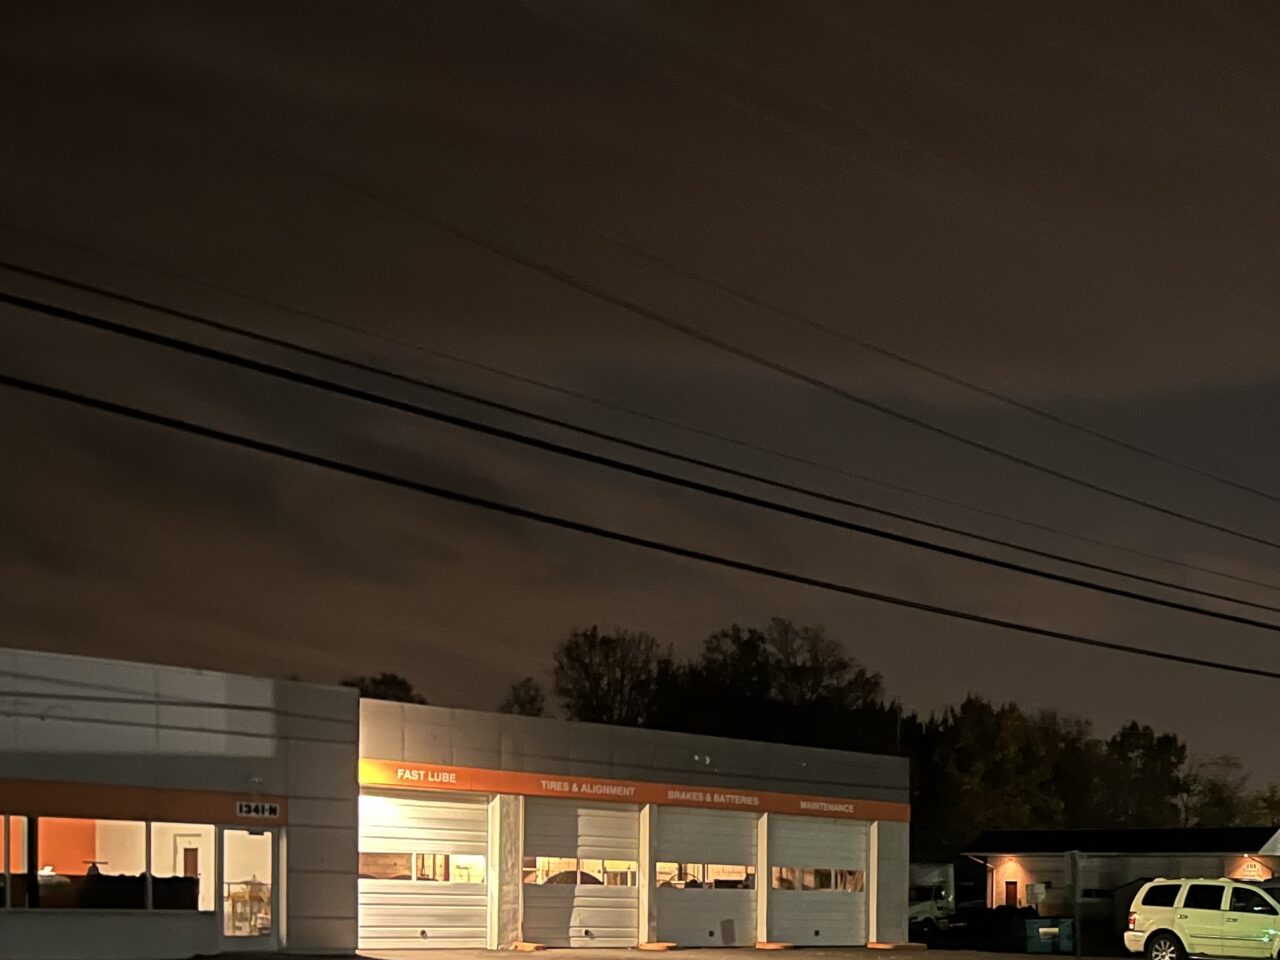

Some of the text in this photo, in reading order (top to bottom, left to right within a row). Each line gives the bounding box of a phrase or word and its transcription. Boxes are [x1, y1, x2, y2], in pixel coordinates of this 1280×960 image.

[397, 768, 457, 784] FAST LUBE
[540, 780, 636, 796] TIRES & ALIGNMENT
[667, 790, 759, 806] BRAKES & BATTERIES
[800, 801, 854, 813] MAINTENANCE
